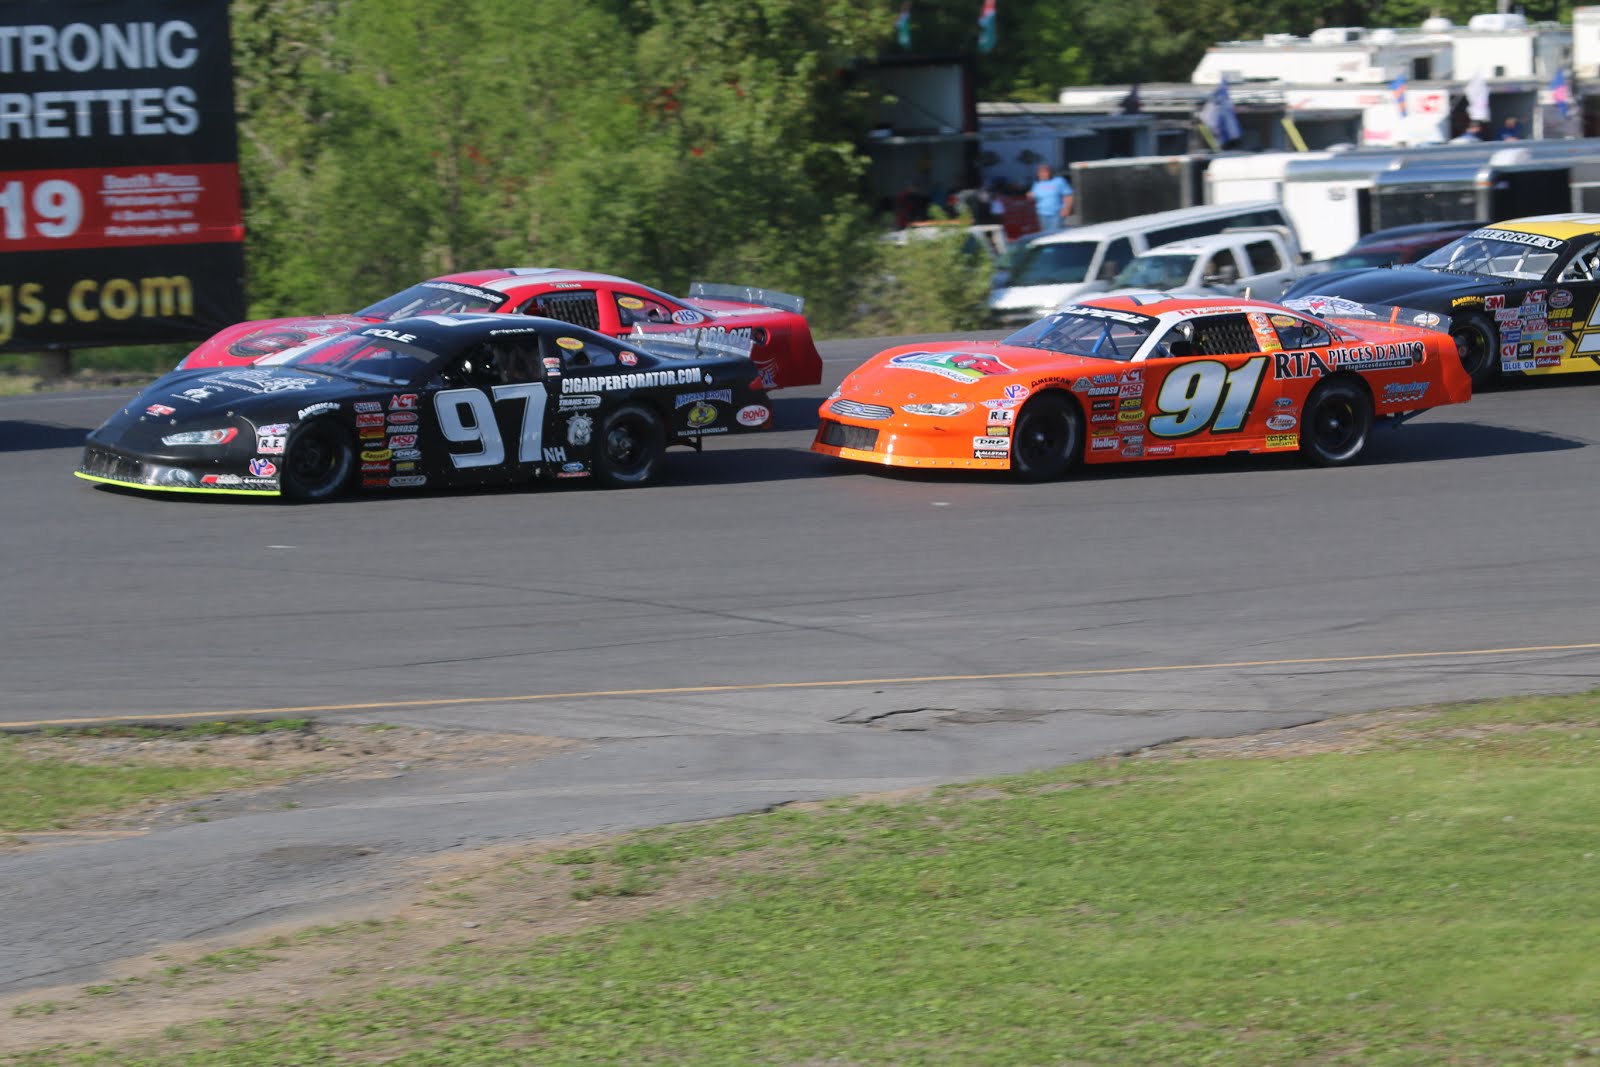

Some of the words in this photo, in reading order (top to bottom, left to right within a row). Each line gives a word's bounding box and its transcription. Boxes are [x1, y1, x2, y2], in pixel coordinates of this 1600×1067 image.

[0, 20, 198, 72] TRONIC
[0, 86, 199, 139] RETTES
[0, 179, 84, 239] 19
[1486, 296, 1504, 309] 3M
[1523, 290, 1547, 303] ACT
[678, 310, 701, 321] HSI
[1502, 320, 1522, 328] MSD
[361, 328, 416, 343] POLE
[1503, 345, 1515, 356] CV
[1274, 351, 1332, 380] RTA
[561, 367, 701, 394] CIGARPERFORATOR.COM
[1031, 376, 1071, 388] AMERICAN
[1120, 369, 1145, 383] ACT
[1088, 387, 1119, 395] MOROSO
[1121, 385, 1142, 394] MSD
[1149, 356, 1270, 437] 91
[388, 394, 418, 409] ACT
[298, 402, 340, 420] AMERICAN
[743, 410, 765, 420] BOND
[433, 382, 548, 469] 97
[392, 435, 416, 444] MSD
[1092, 438, 1118, 449] Holley
[543, 447, 566, 462] NH
